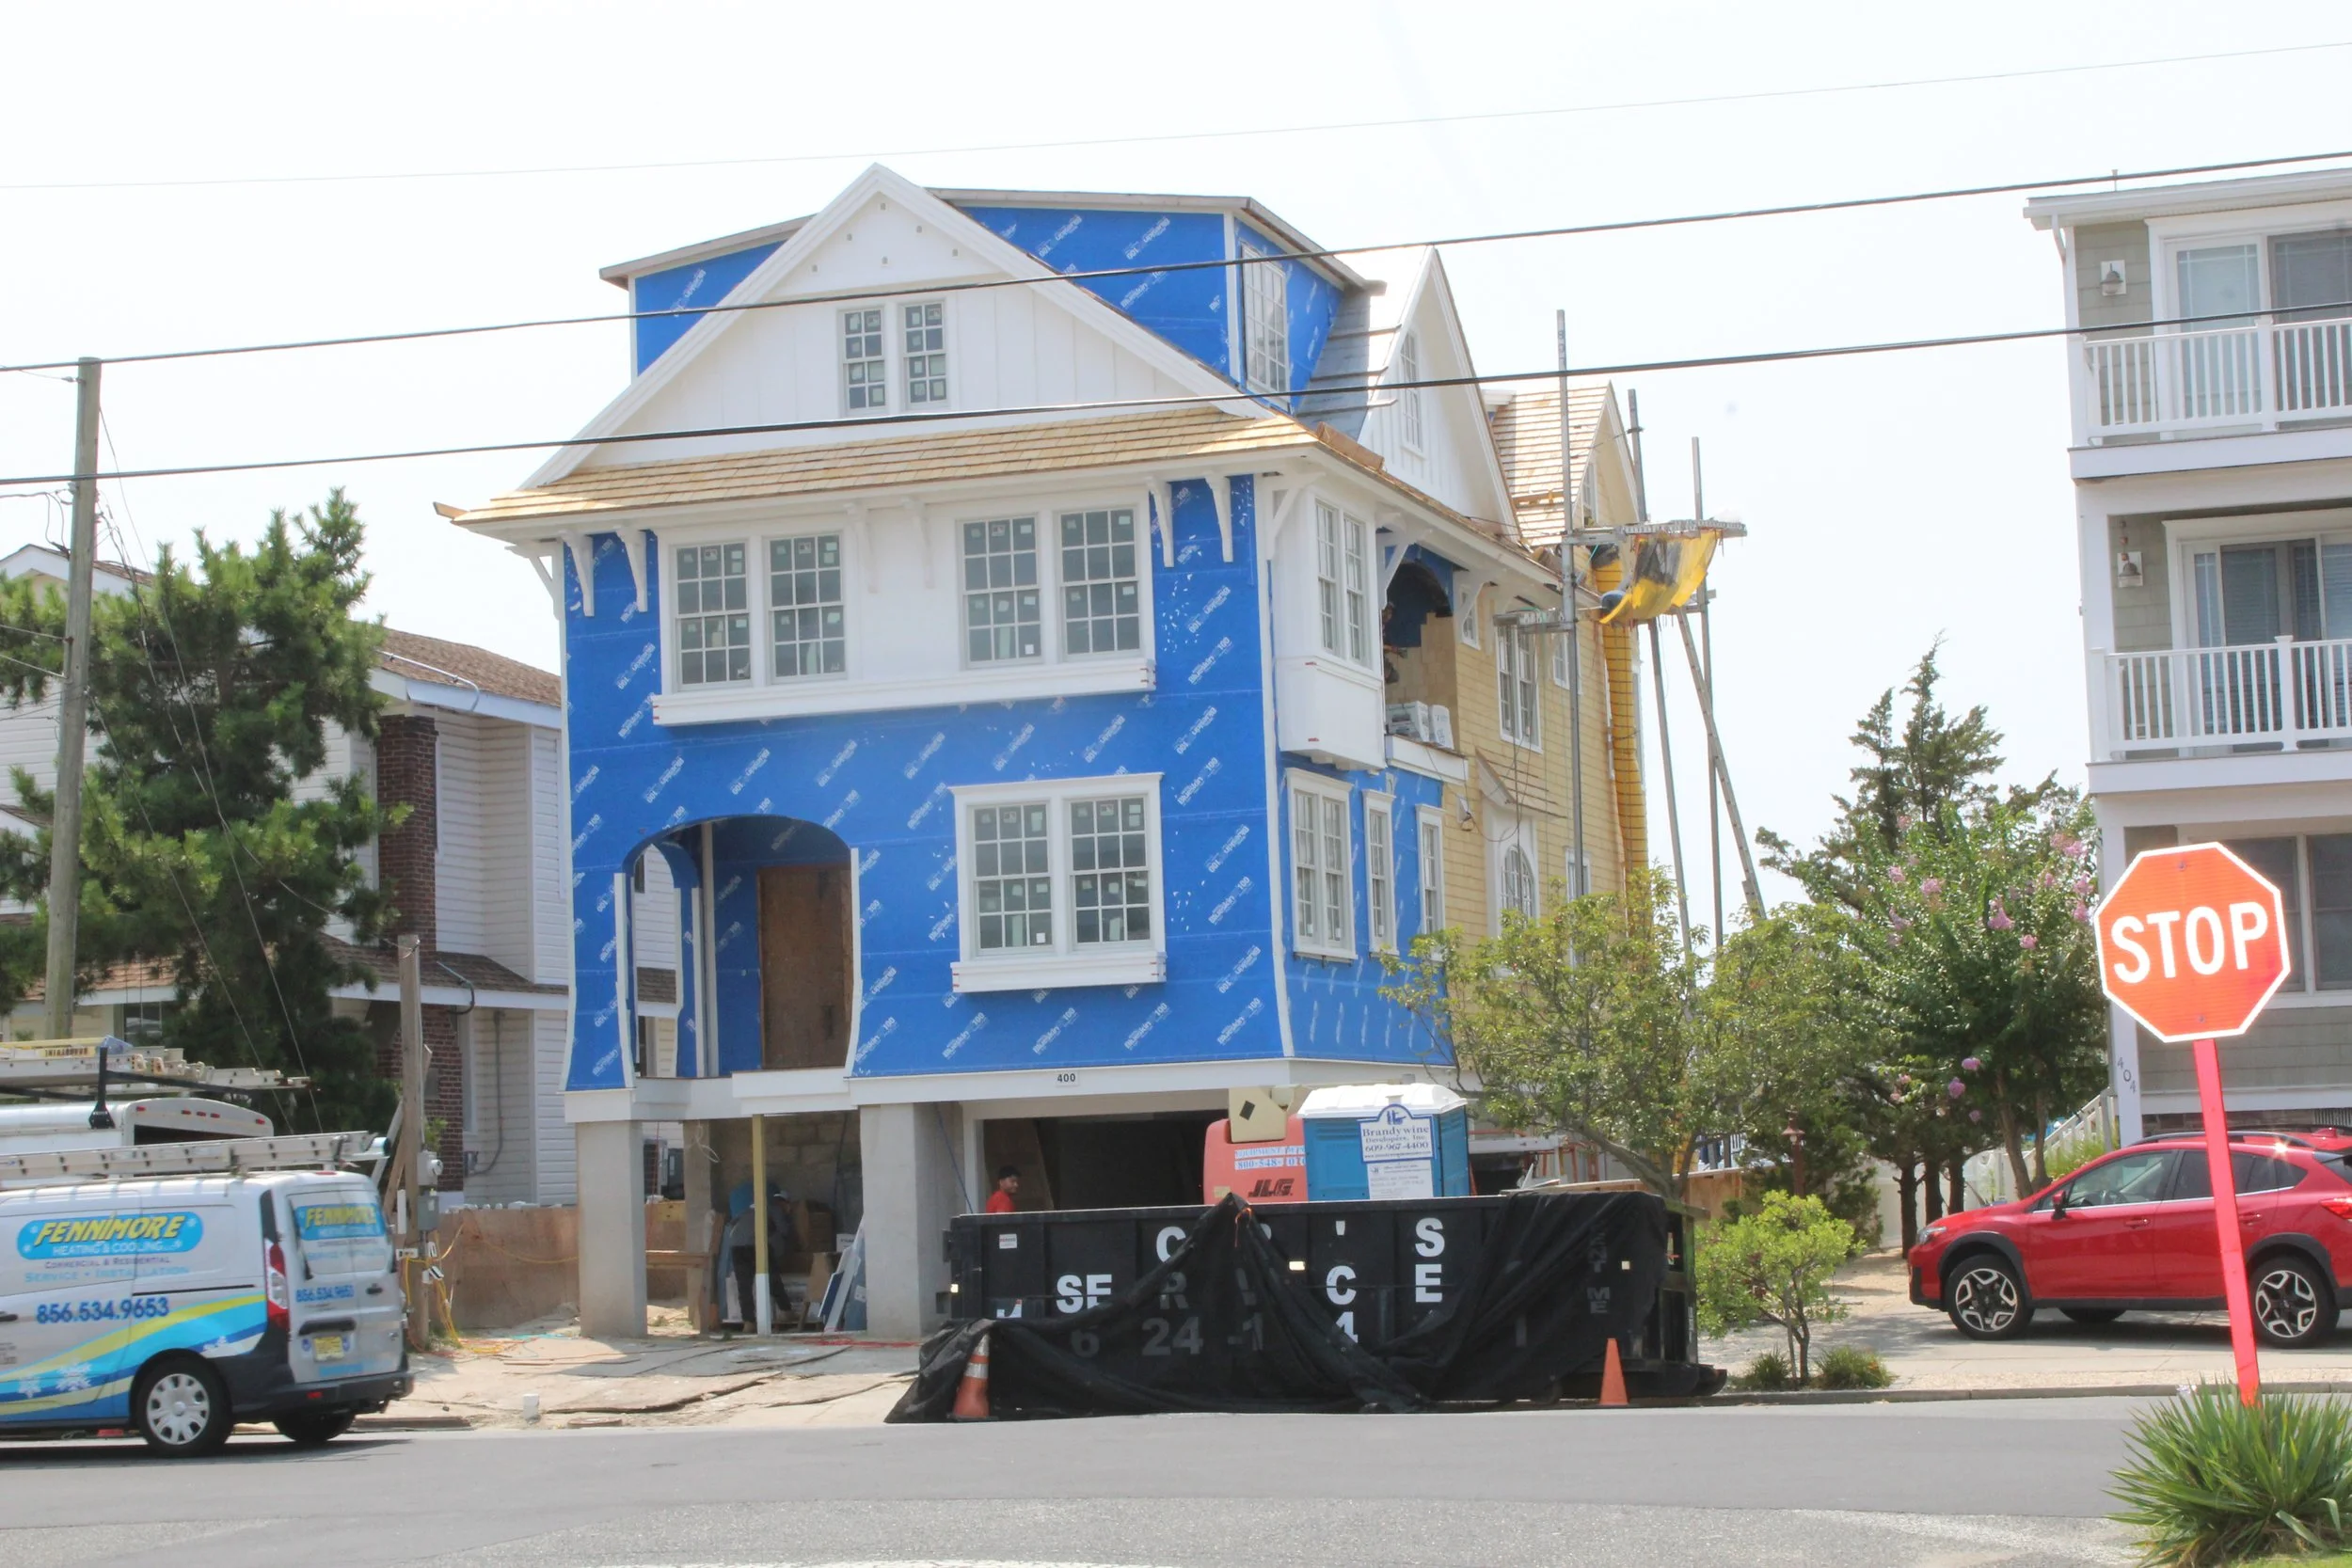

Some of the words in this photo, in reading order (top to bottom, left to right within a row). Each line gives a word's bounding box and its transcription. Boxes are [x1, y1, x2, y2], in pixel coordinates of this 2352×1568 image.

[2111, 901, 2268, 984] STOP
[1057, 1072, 1076, 1084] 400
[1363, 1126, 1429, 1137] Brandywine
[1248, 1179, 1295, 1197] JLG
[34, 1210, 186, 1247] FENNIMORE
[53, 1242, 101, 1256] HEATING
[37, 1297, 169, 1324] 856.534.9653
